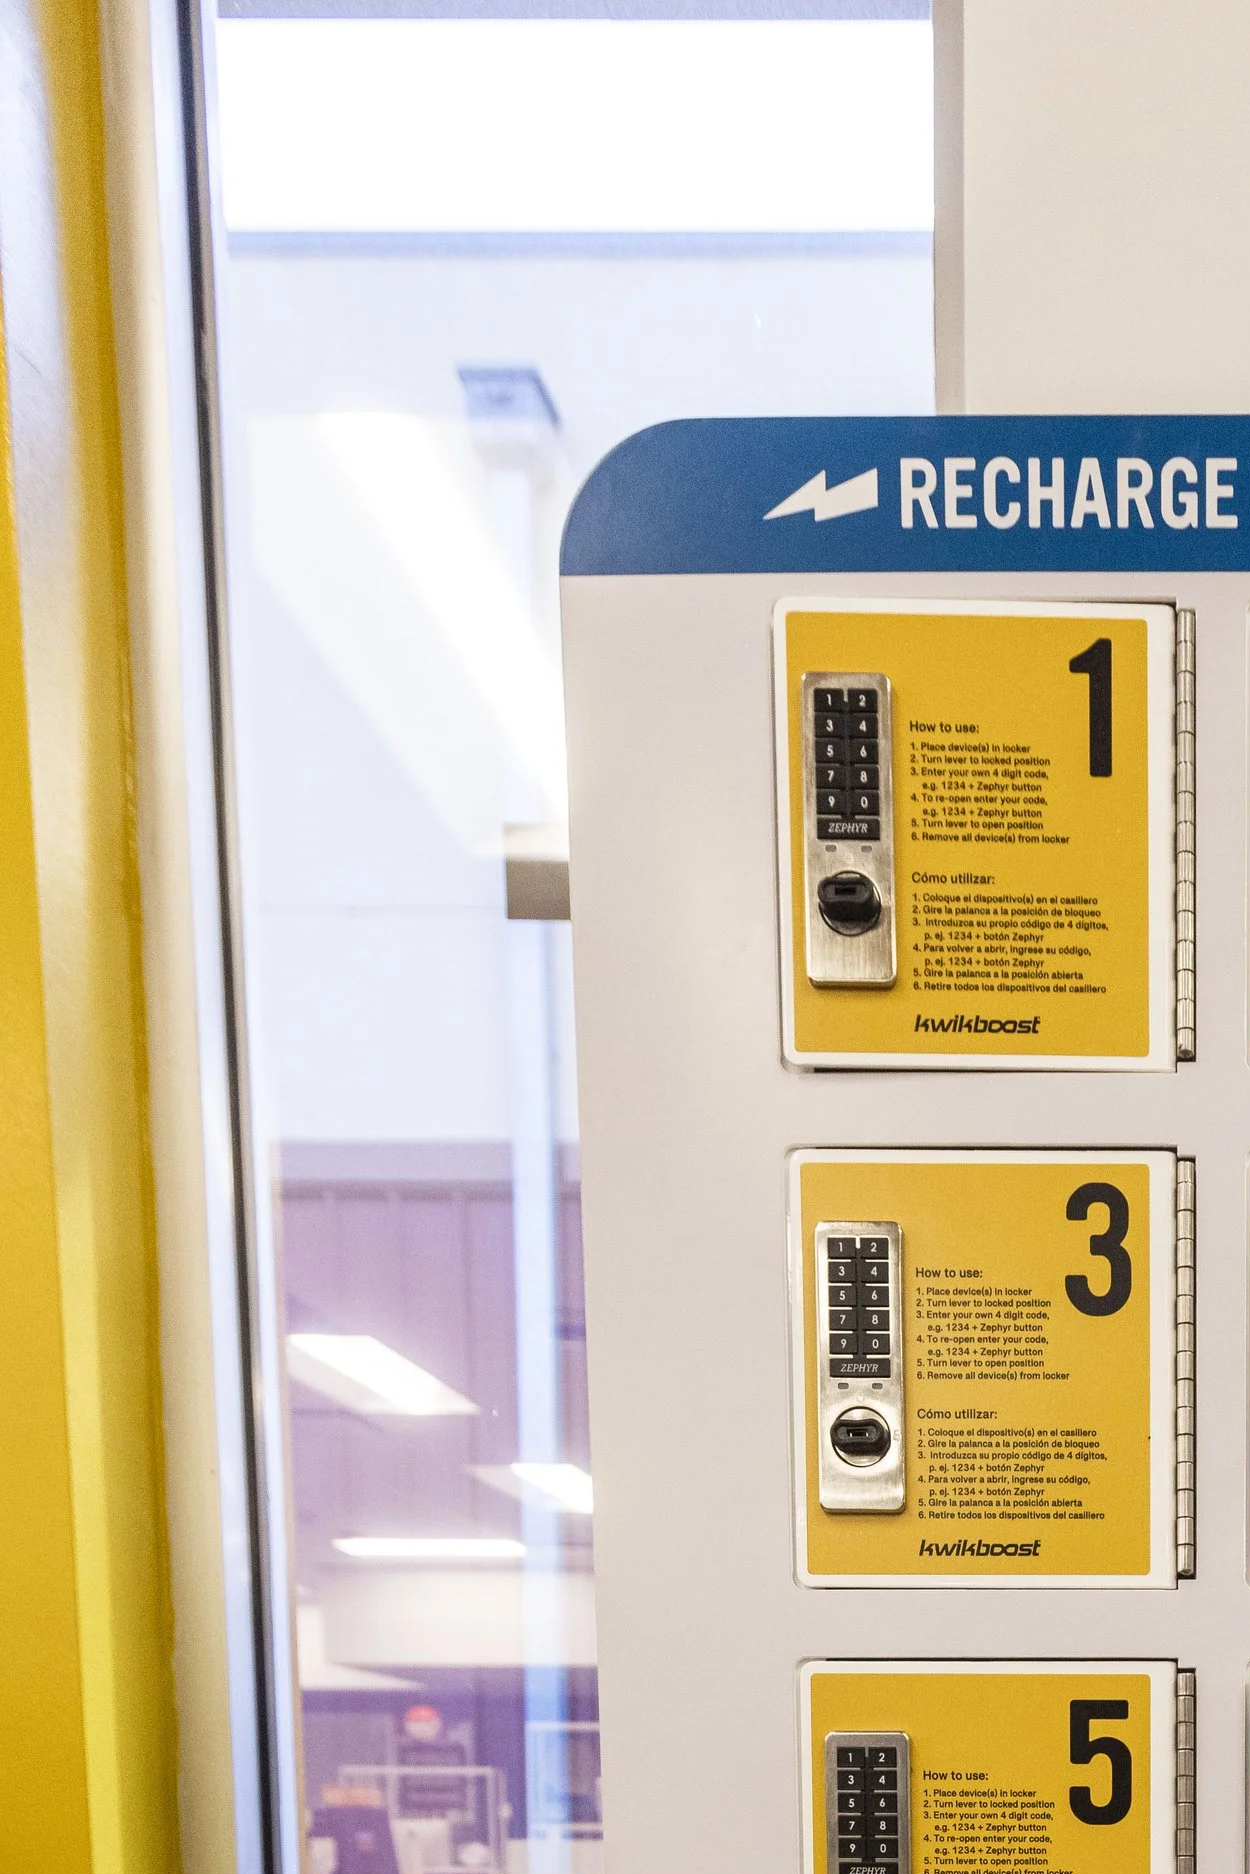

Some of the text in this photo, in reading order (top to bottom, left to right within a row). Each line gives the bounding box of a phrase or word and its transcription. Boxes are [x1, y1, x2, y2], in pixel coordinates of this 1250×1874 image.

[900, 456, 1239, 530] RECHARGE
[1068, 637, 1113, 778] 1
[909, 719, 980, 734] How to use:
[827, 822, 869, 834] ZEPHYR
[911, 871, 995, 885] Cómo utilizar:
[914, 1014, 1041, 1034] kwikboost
[1064, 1182, 1132, 1317] 3
[915, 1267, 983, 1279] How to use:
[839, 1363, 879, 1373] ZEPHYR
[916, 1408, 998, 1420] Cómo utilizar:
[917, 1427, 1097, 1439] 1. Coloque el dispositivo(s) en el casillero
[917, 1439, 926, 1448] 2.
[927, 1439, 947, 1448] Gire
[948, 1439, 957, 1448] la
[958, 1439, 994, 1450] palanca
[1002, 1439, 1011, 1448] la
[1012, 1439, 1050, 1450] posición
[1051, 1439, 1063, 1449] de
[1064, 1439, 1100, 1450] bloqueo
[918, 1539, 1042, 1557] kwikboost
[1068, 1699, 1133, 1826] 5
[923, 1769, 989, 1781] How to use:
[923, 1788, 1037, 1799] 1. Place device(s) in locker
[923, 1799, 1055, 1810] 2. Turn lever to locked position
[923, 1810, 1054, 1822] 3. Enter your own 4 digit code,
